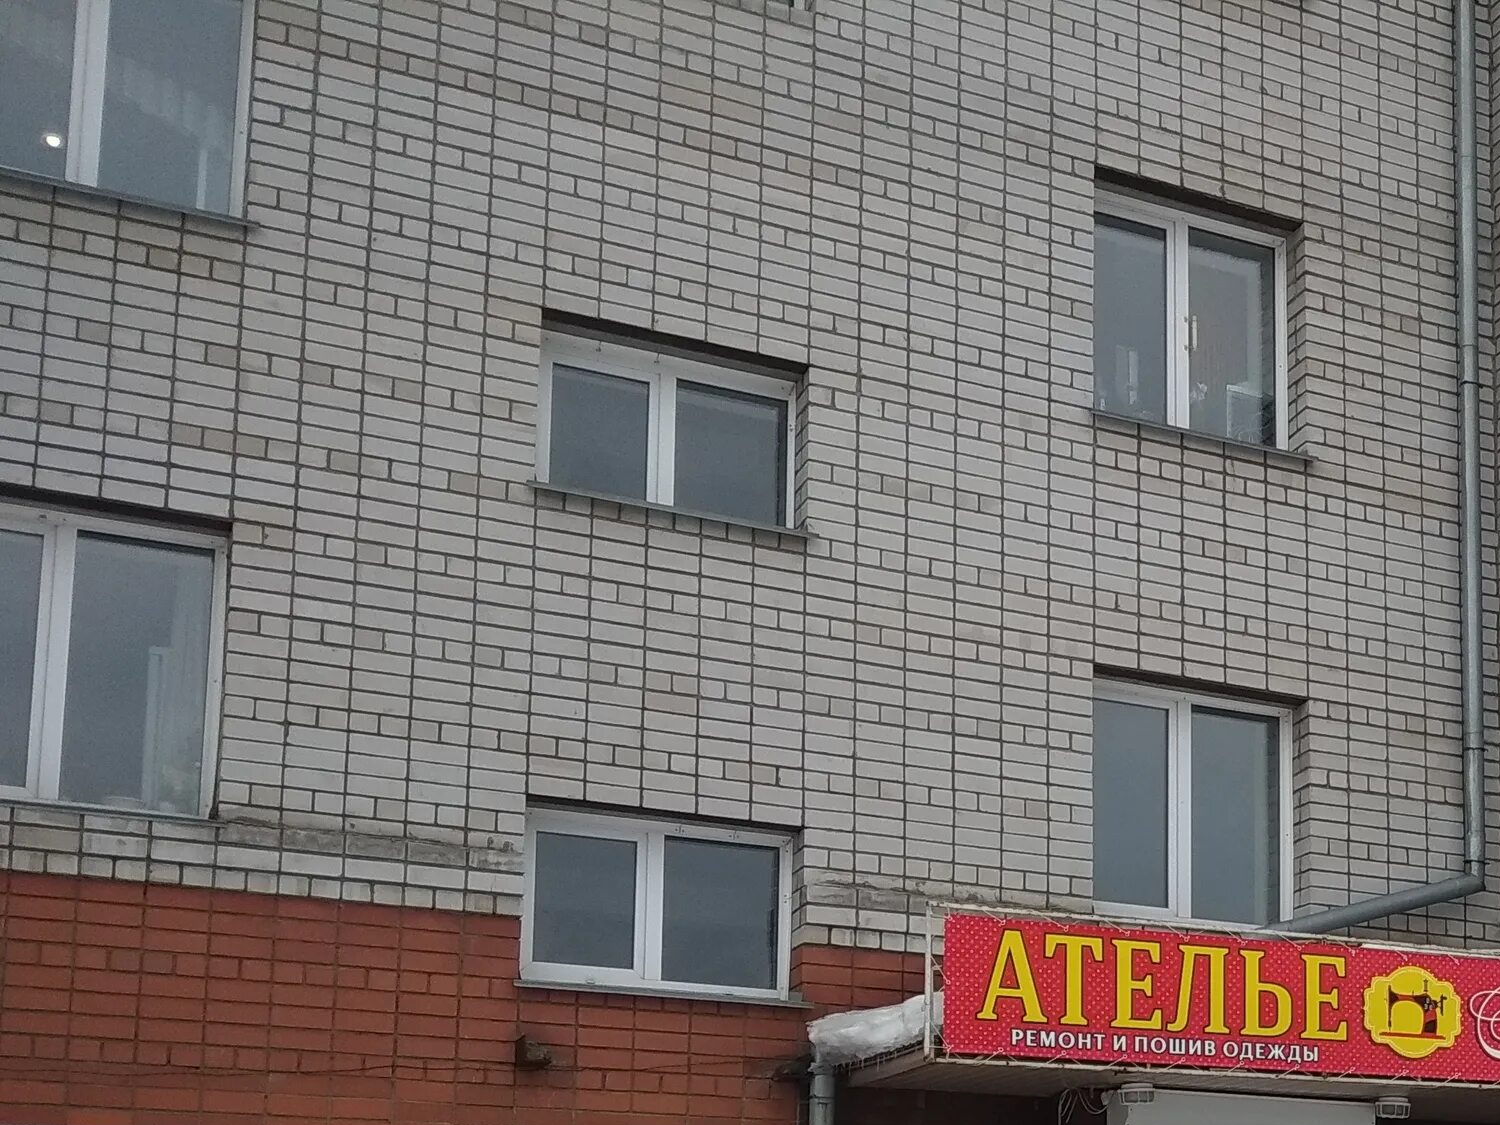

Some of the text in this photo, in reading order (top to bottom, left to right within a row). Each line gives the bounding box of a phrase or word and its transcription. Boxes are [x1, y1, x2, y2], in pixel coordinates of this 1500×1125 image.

[975, 929, 1348, 1041] АТЕЛЬЕ
[1010, 1029, 1320, 1063] РЕМОНТ И ПОШИВ ОДЕЖДЫ
